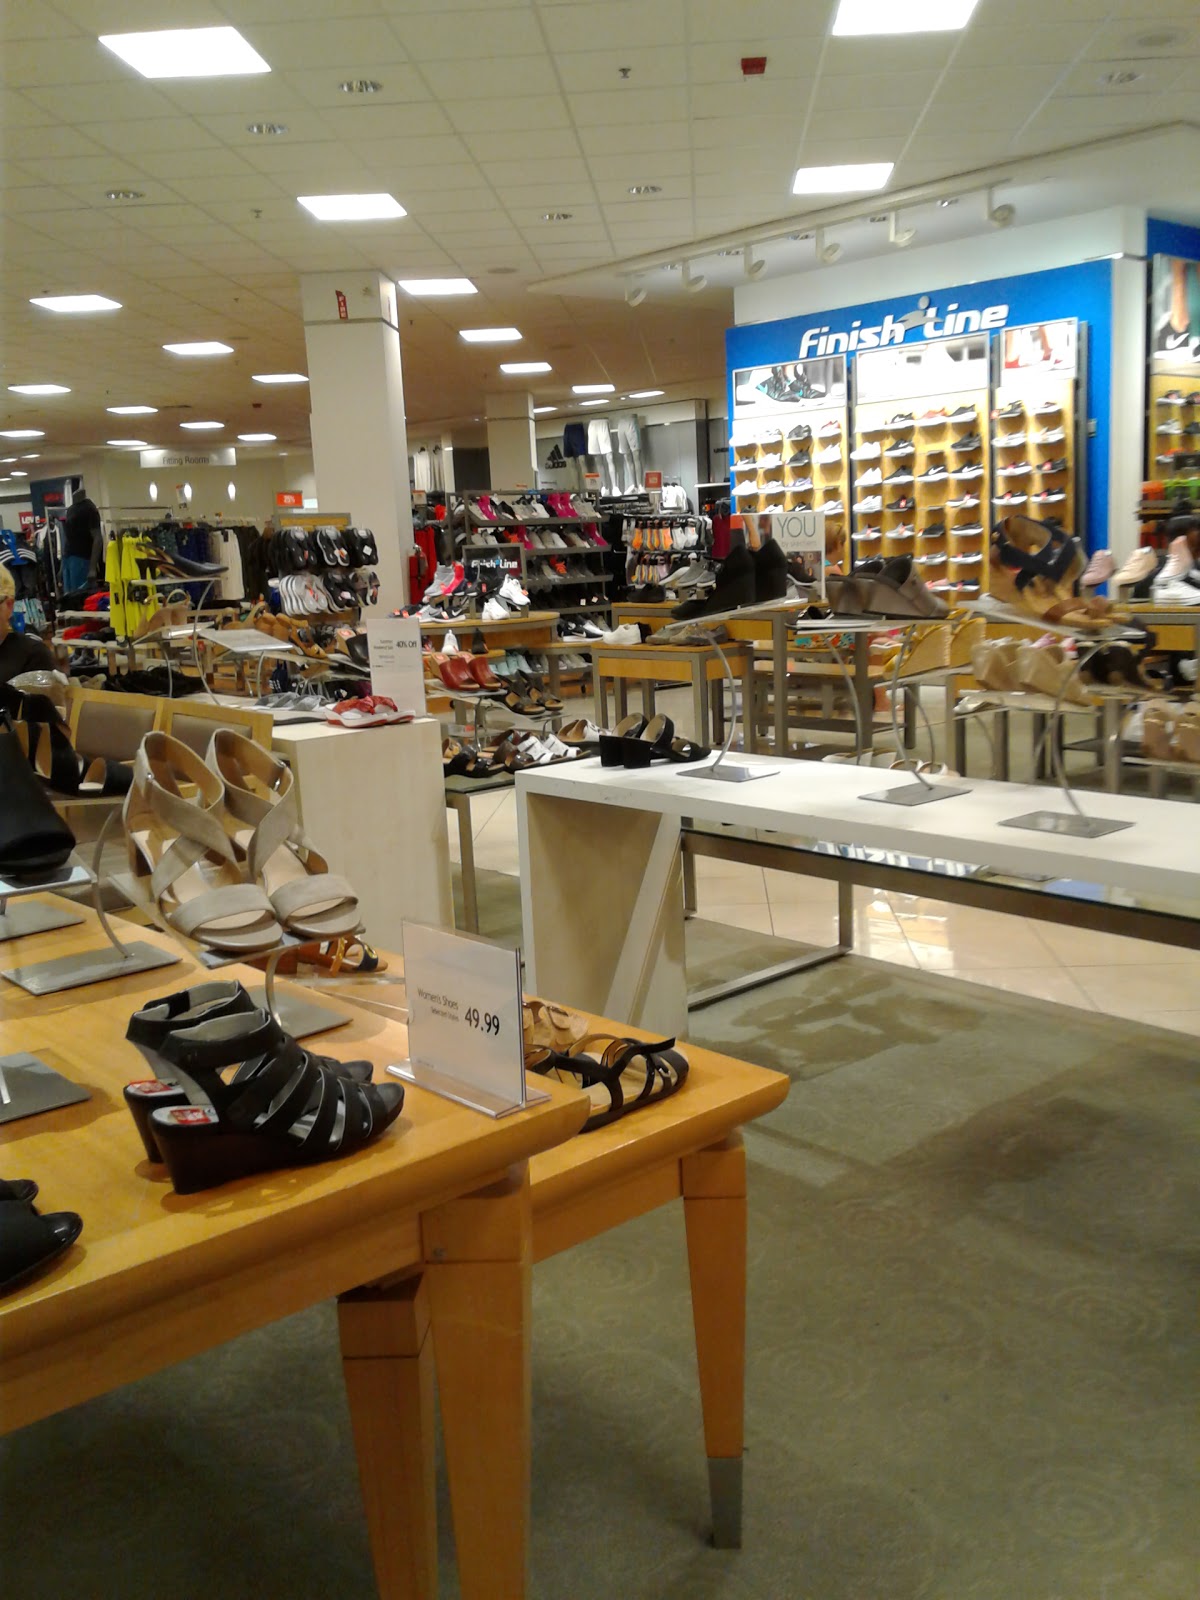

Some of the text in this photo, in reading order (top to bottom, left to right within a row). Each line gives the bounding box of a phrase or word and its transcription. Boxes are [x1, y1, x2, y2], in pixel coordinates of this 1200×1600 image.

[798, 303, 1010, 359] Finish Line
[162, 455, 210, 466] Fitting Rooms
[776, 515, 816, 538] YOU
[416, 985, 459, 1010] Women's Shoes
[464, 1006, 500, 1036] 49.99
